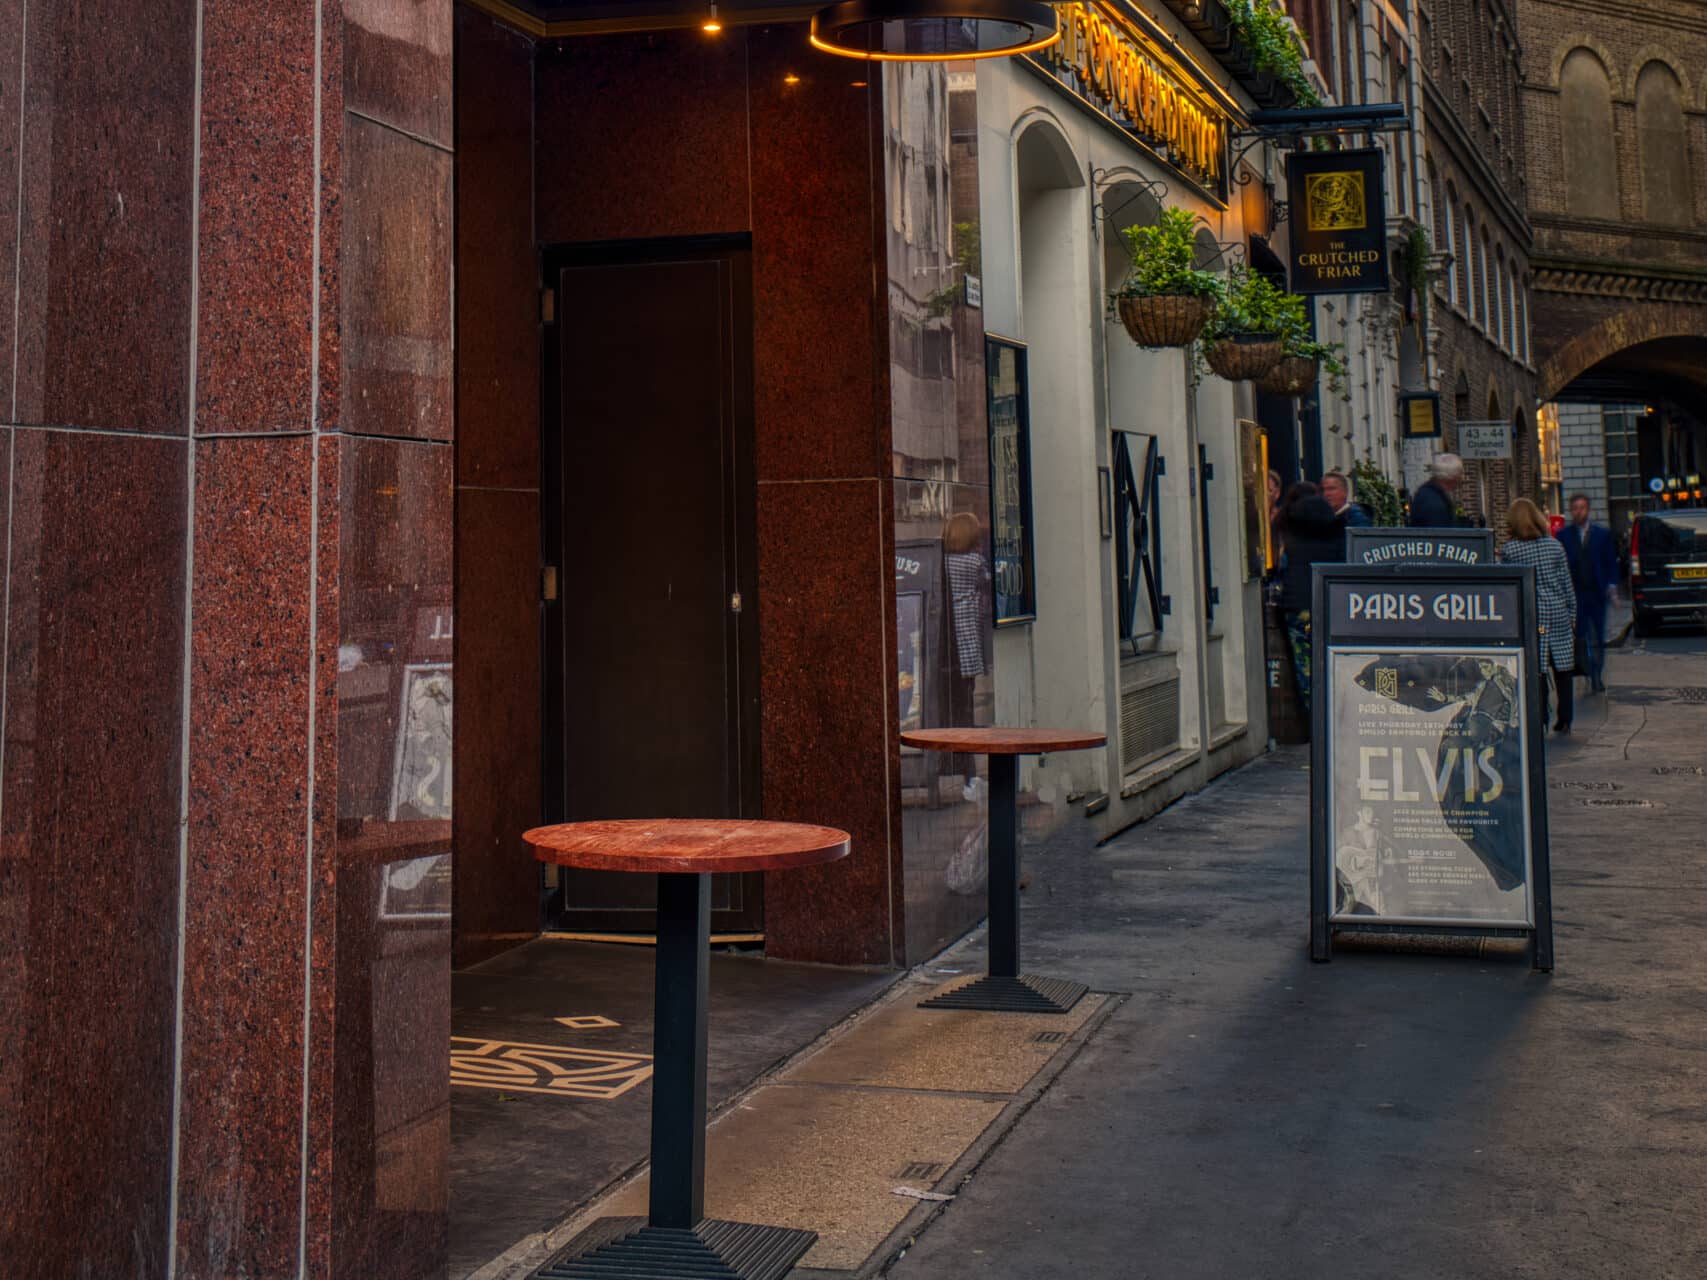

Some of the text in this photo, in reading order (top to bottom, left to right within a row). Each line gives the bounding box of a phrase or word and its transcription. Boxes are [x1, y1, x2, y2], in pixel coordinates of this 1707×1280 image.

[1329, 241, 1345, 250] THE
[1298, 250, 1379, 266] CRUTCHED
[1317, 265, 1361, 279] FRIAR
[1465, 428, 1480, 439] 43
[1490, 428, 1504, 438] 44
[1468, 440, 1504, 449] Crutched
[1363, 542, 1478, 565] CRUTCHED FRIAR
[1348, 592, 1503, 621] PARIS GRILL
[1359, 746, 1504, 802] ELVIS
